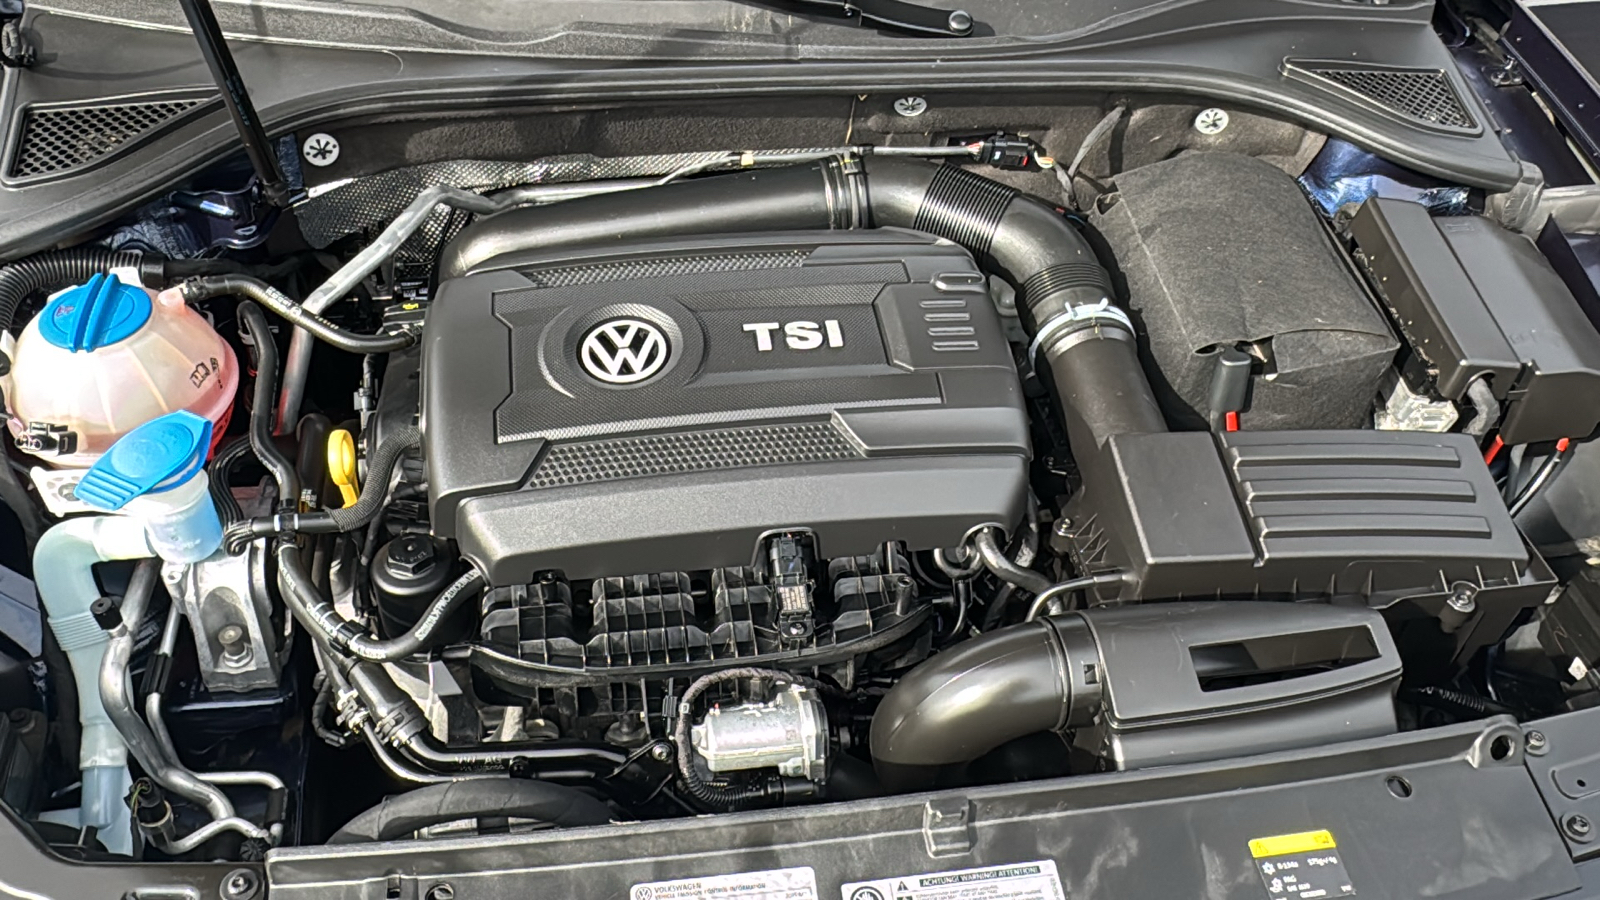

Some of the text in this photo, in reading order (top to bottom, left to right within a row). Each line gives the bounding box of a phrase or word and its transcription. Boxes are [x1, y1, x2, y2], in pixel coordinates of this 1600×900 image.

[742, 318, 845, 352] TSI
[923, 867, 1038, 887] ACHTUNG! WARNING! ATTENTION!
[654, 883, 702, 893] VOLKSWAGEN
